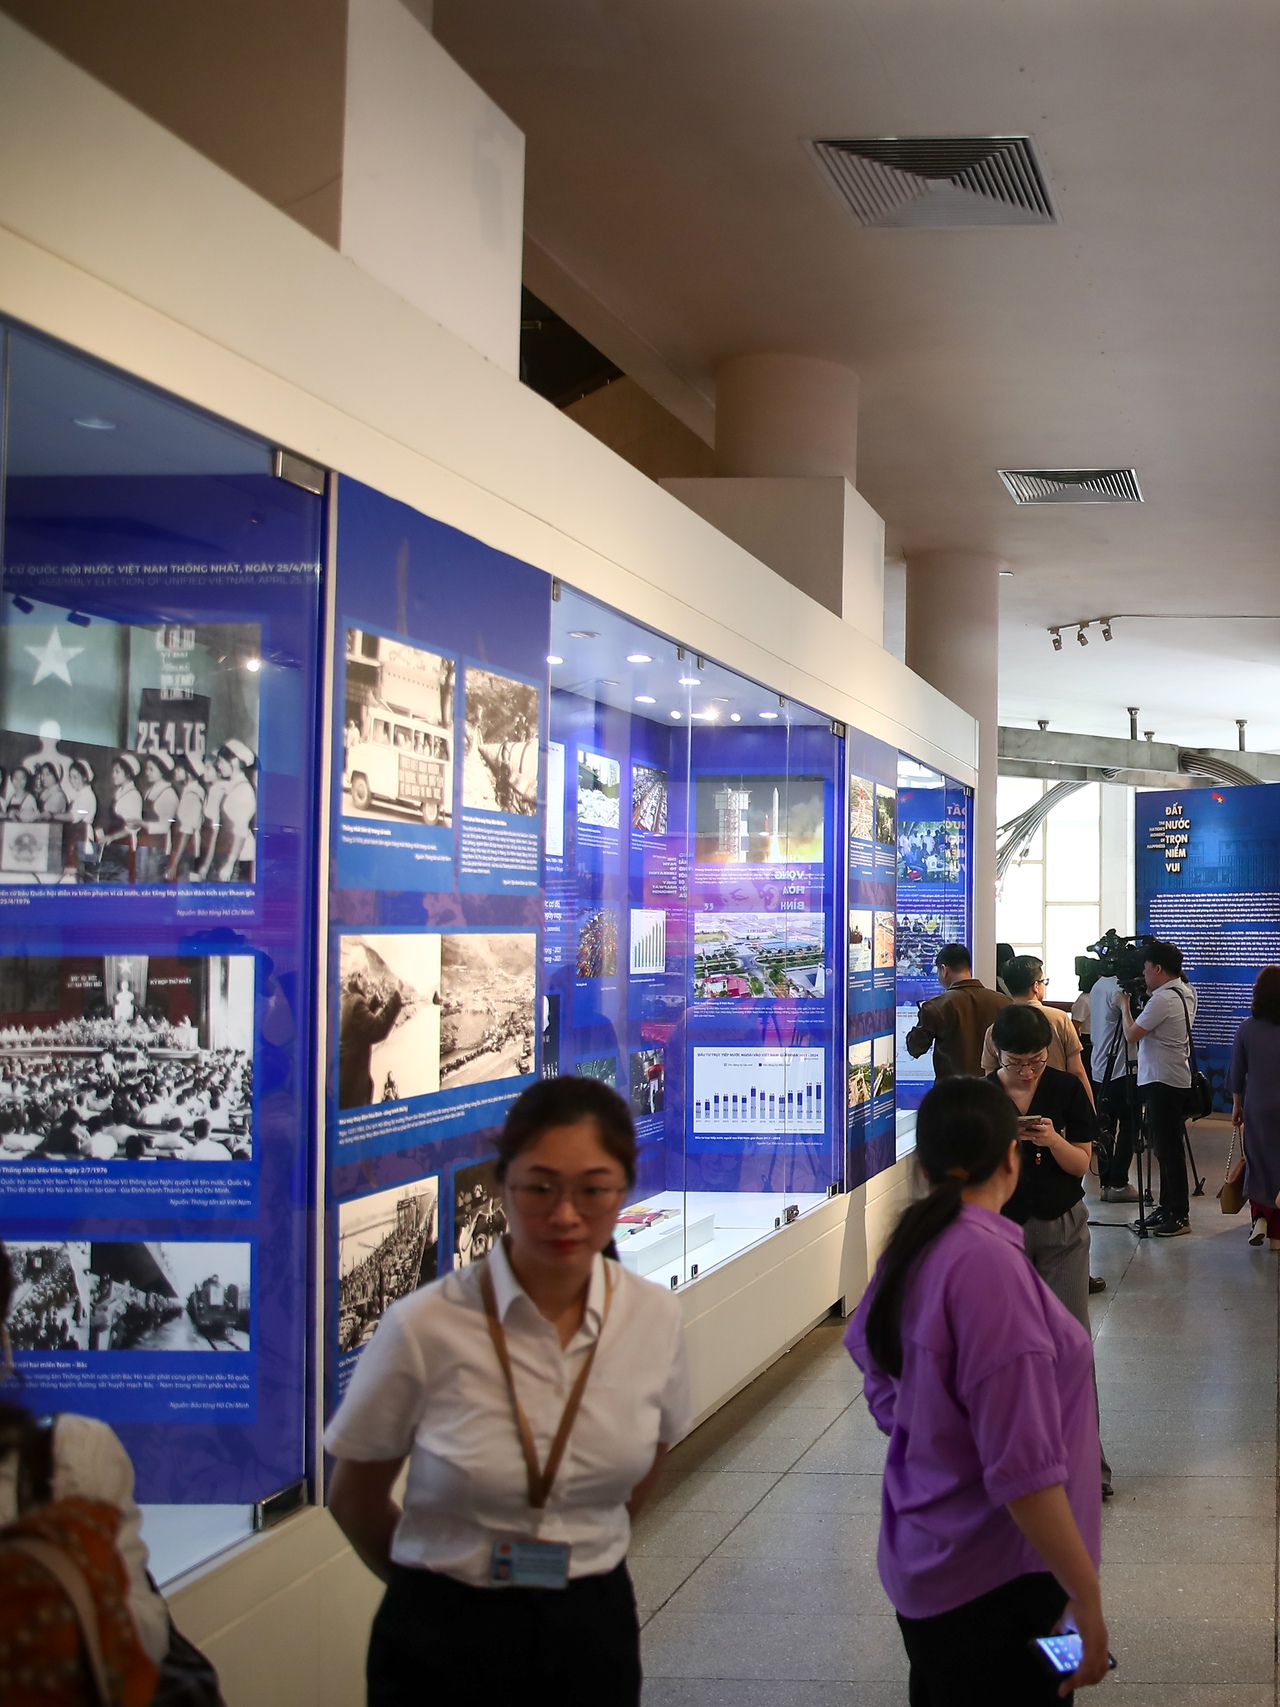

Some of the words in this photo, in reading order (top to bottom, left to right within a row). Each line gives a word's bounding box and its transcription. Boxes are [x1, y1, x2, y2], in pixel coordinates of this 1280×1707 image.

[62, 563, 81, 575] HỘI
[84, 563, 115, 574] NƯỚC
[118, 563, 141, 575] VIỆT
[144, 565, 168, 574] NAM
[171, 562, 208, 574] THỐNG
[211, 562, 243, 574] NHẤT,
[246, 562, 274, 573] NGÀY
[95, 577, 145, 586] ELECTION
[148, 577, 160, 586] OF
[165, 577, 206, 586] UNIFIED
[1165, 802, 1183, 816] ĐẤT
[1165, 817, 1190, 830] NƯỚC
[1165, 834, 1188, 845] TRỌN
[1165, 845, 1186, 858] NIỀM
[1165, 862, 1181, 872] VUI
